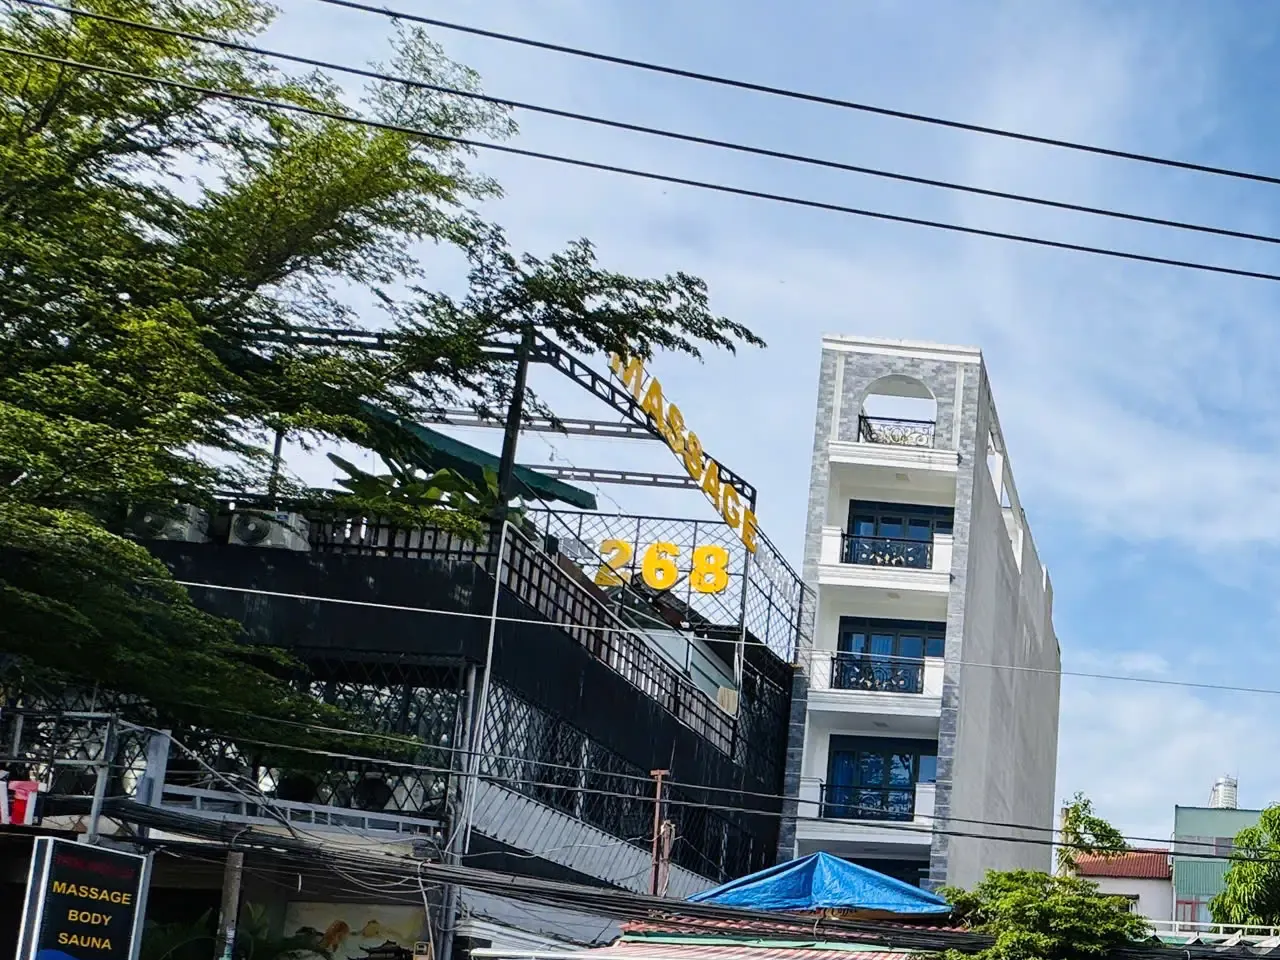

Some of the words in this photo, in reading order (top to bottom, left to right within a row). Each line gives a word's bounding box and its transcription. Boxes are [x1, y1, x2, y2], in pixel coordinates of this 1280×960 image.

[607, 351, 760, 553] MASSAGE
[594, 538, 729, 593] 268
[52, 881, 132, 905] MASSAGE
[68, 909, 112, 926] BODY
[57, 932, 112, 950] SAUNA
